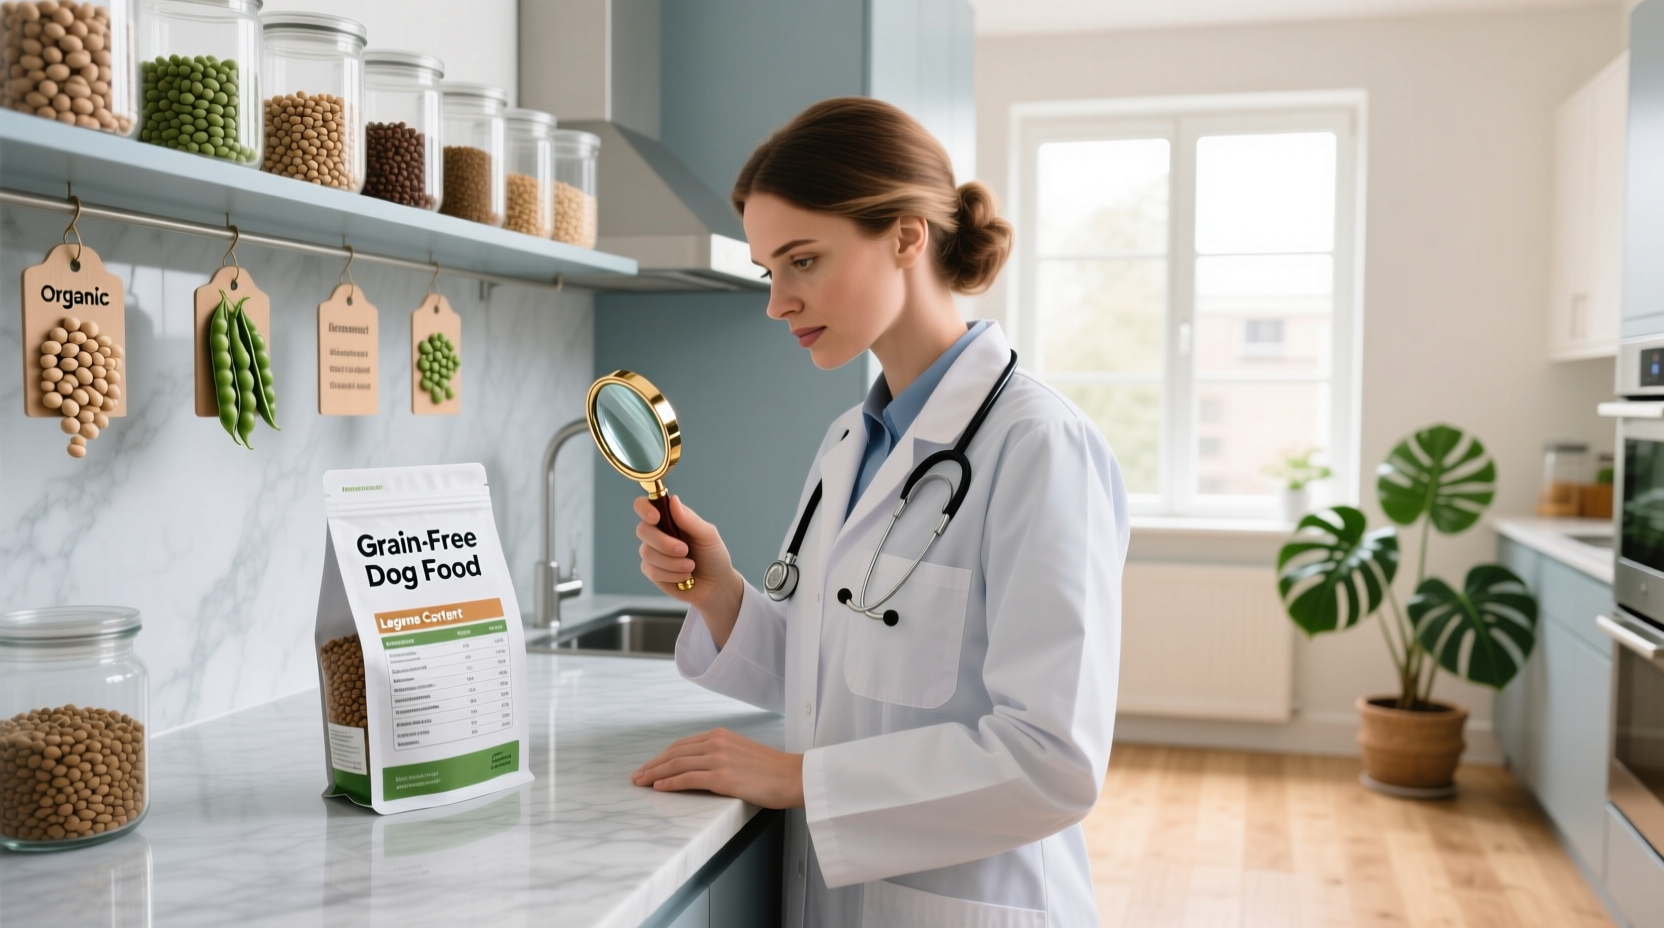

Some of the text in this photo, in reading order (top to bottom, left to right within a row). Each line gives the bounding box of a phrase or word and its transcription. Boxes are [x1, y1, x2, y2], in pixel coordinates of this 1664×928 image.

[40, 285, 110, 309] Organic
[357, 529, 477, 558] Grain-Free
[365, 555, 482, 590] Dog Food
